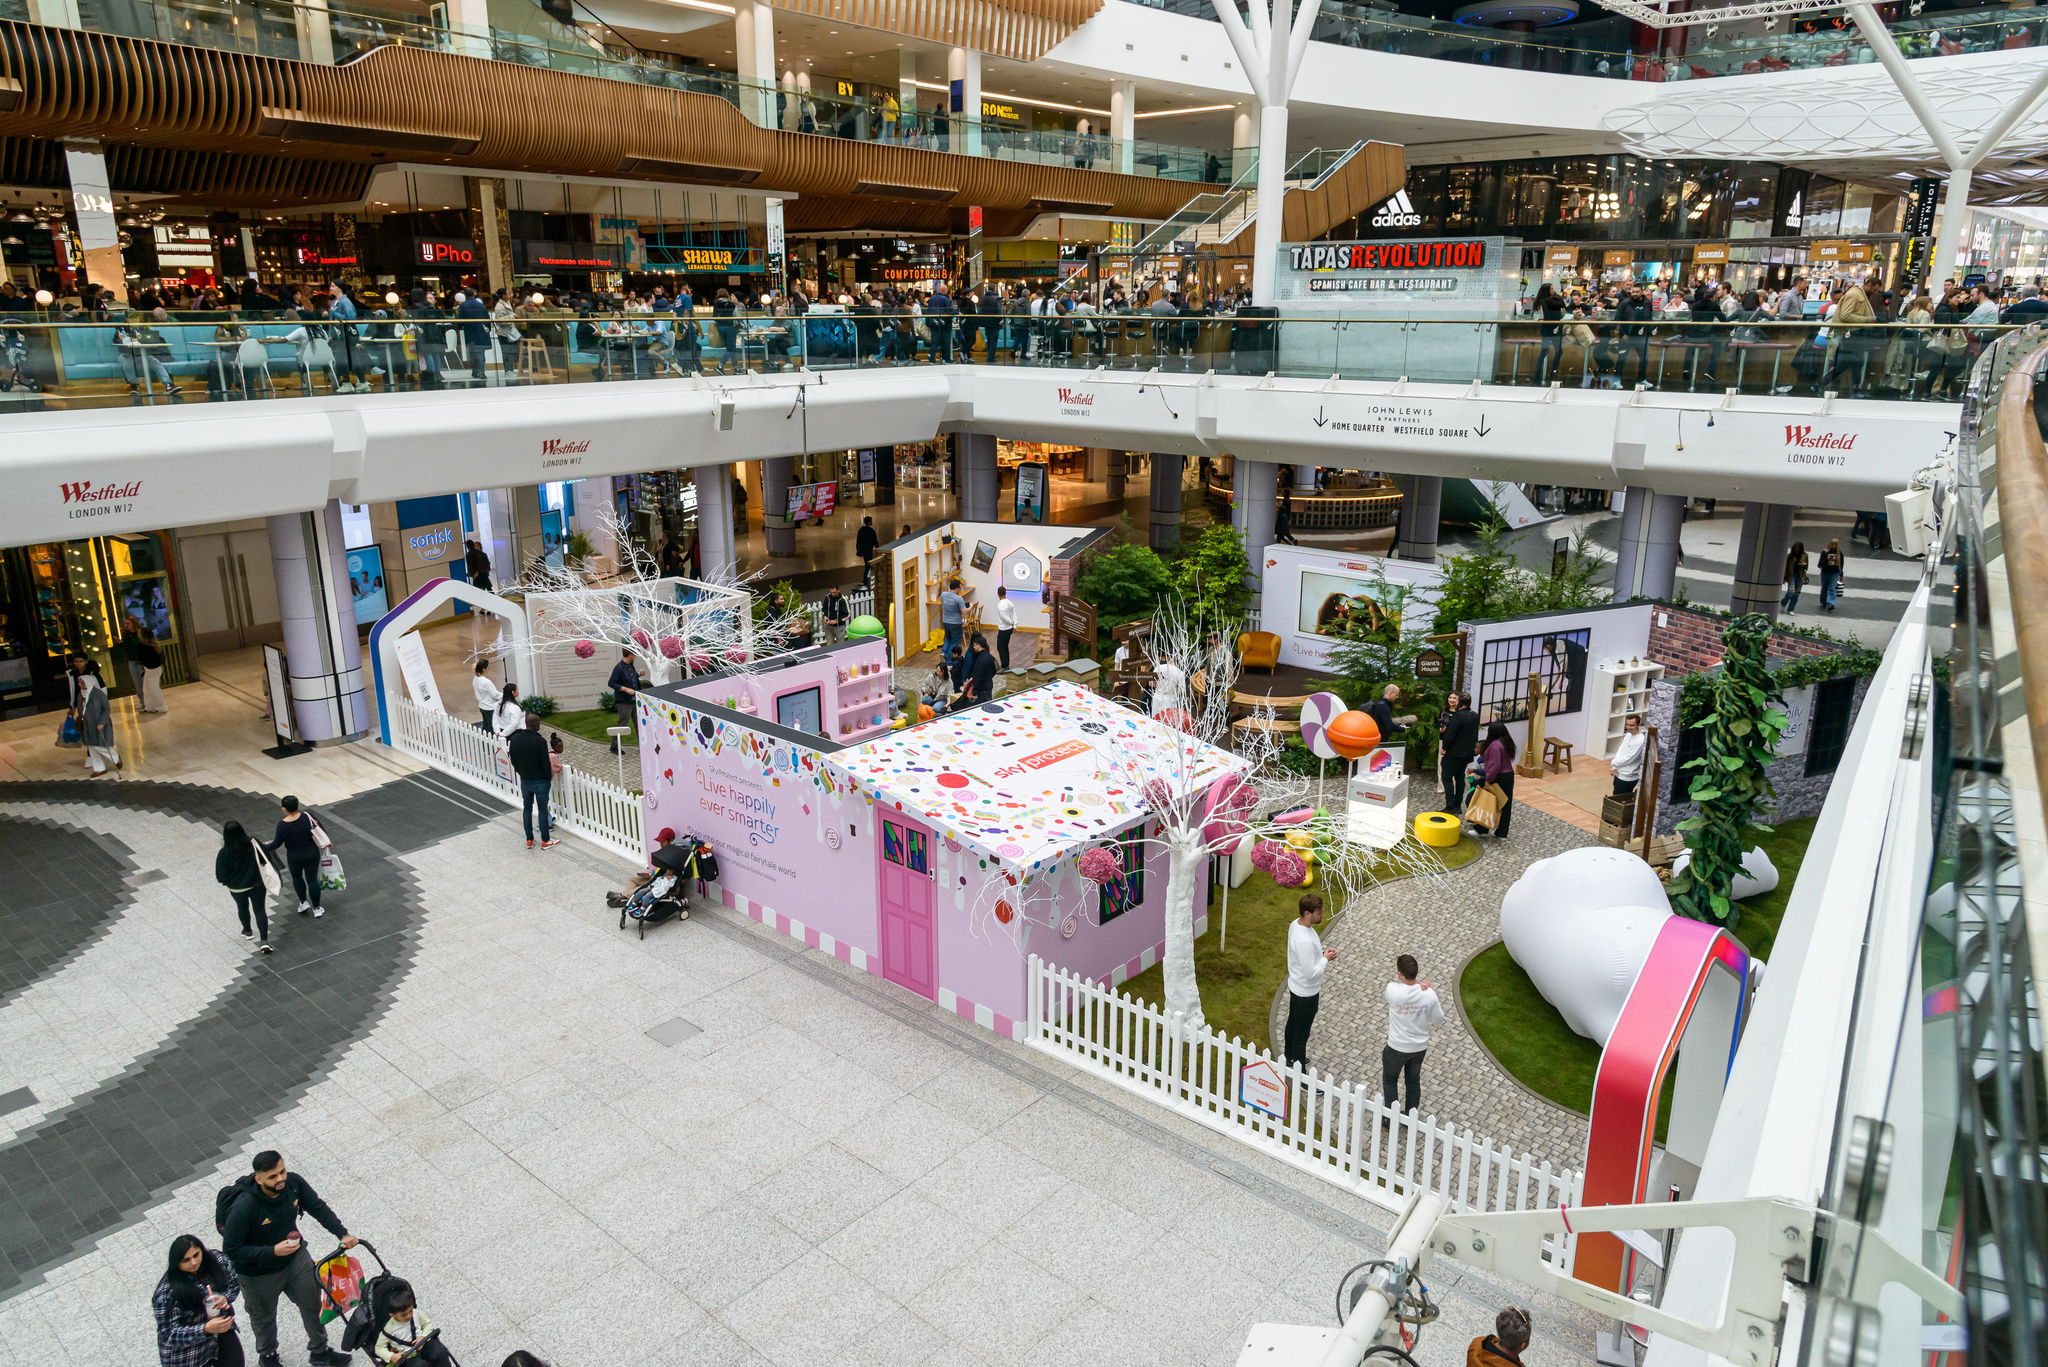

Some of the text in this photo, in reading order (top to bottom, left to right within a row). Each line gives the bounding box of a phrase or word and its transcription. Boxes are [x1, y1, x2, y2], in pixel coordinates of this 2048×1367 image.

[980, 102, 1003, 118] RON
[1371, 212, 1422, 227] adidas
[436, 243, 473, 263] Pho
[538, 256, 612, 267] Vietnamese street food
[884, 268, 931, 280] COMPTOIR
[1311, 278, 1453, 290] SPANISH CAFE BAR & RESTAURANT
[1057, 387, 1095, 406] Westfield
[1061, 408, 1080, 416] LONDON
[1367, 405, 1434, 416] JOHN LEWIS
[1384, 416, 1421, 424] PARTNERS
[1331, 422, 1469, 438] HOME QUARTER WESTFIELD SQUARE
[1783, 424, 1859, 450] Westfield
[542, 438, 592, 456] Westfield
[543, 459, 569, 468] LONDON
[1787, 453, 1846, 466] LONDON W12
[58, 480, 144, 505] Westfield
[69, 503, 133, 519] LONDON W12
[410, 527, 455, 550] sonisk
[994, 740, 1086, 779] sky protect
[696, 767, 776, 819] Live happily
[700, 797, 780, 838] ever smarter
[726, 843, 750, 858] magical
[750, 851, 777, 870] fairytale
[777, 864, 797, 879] world
